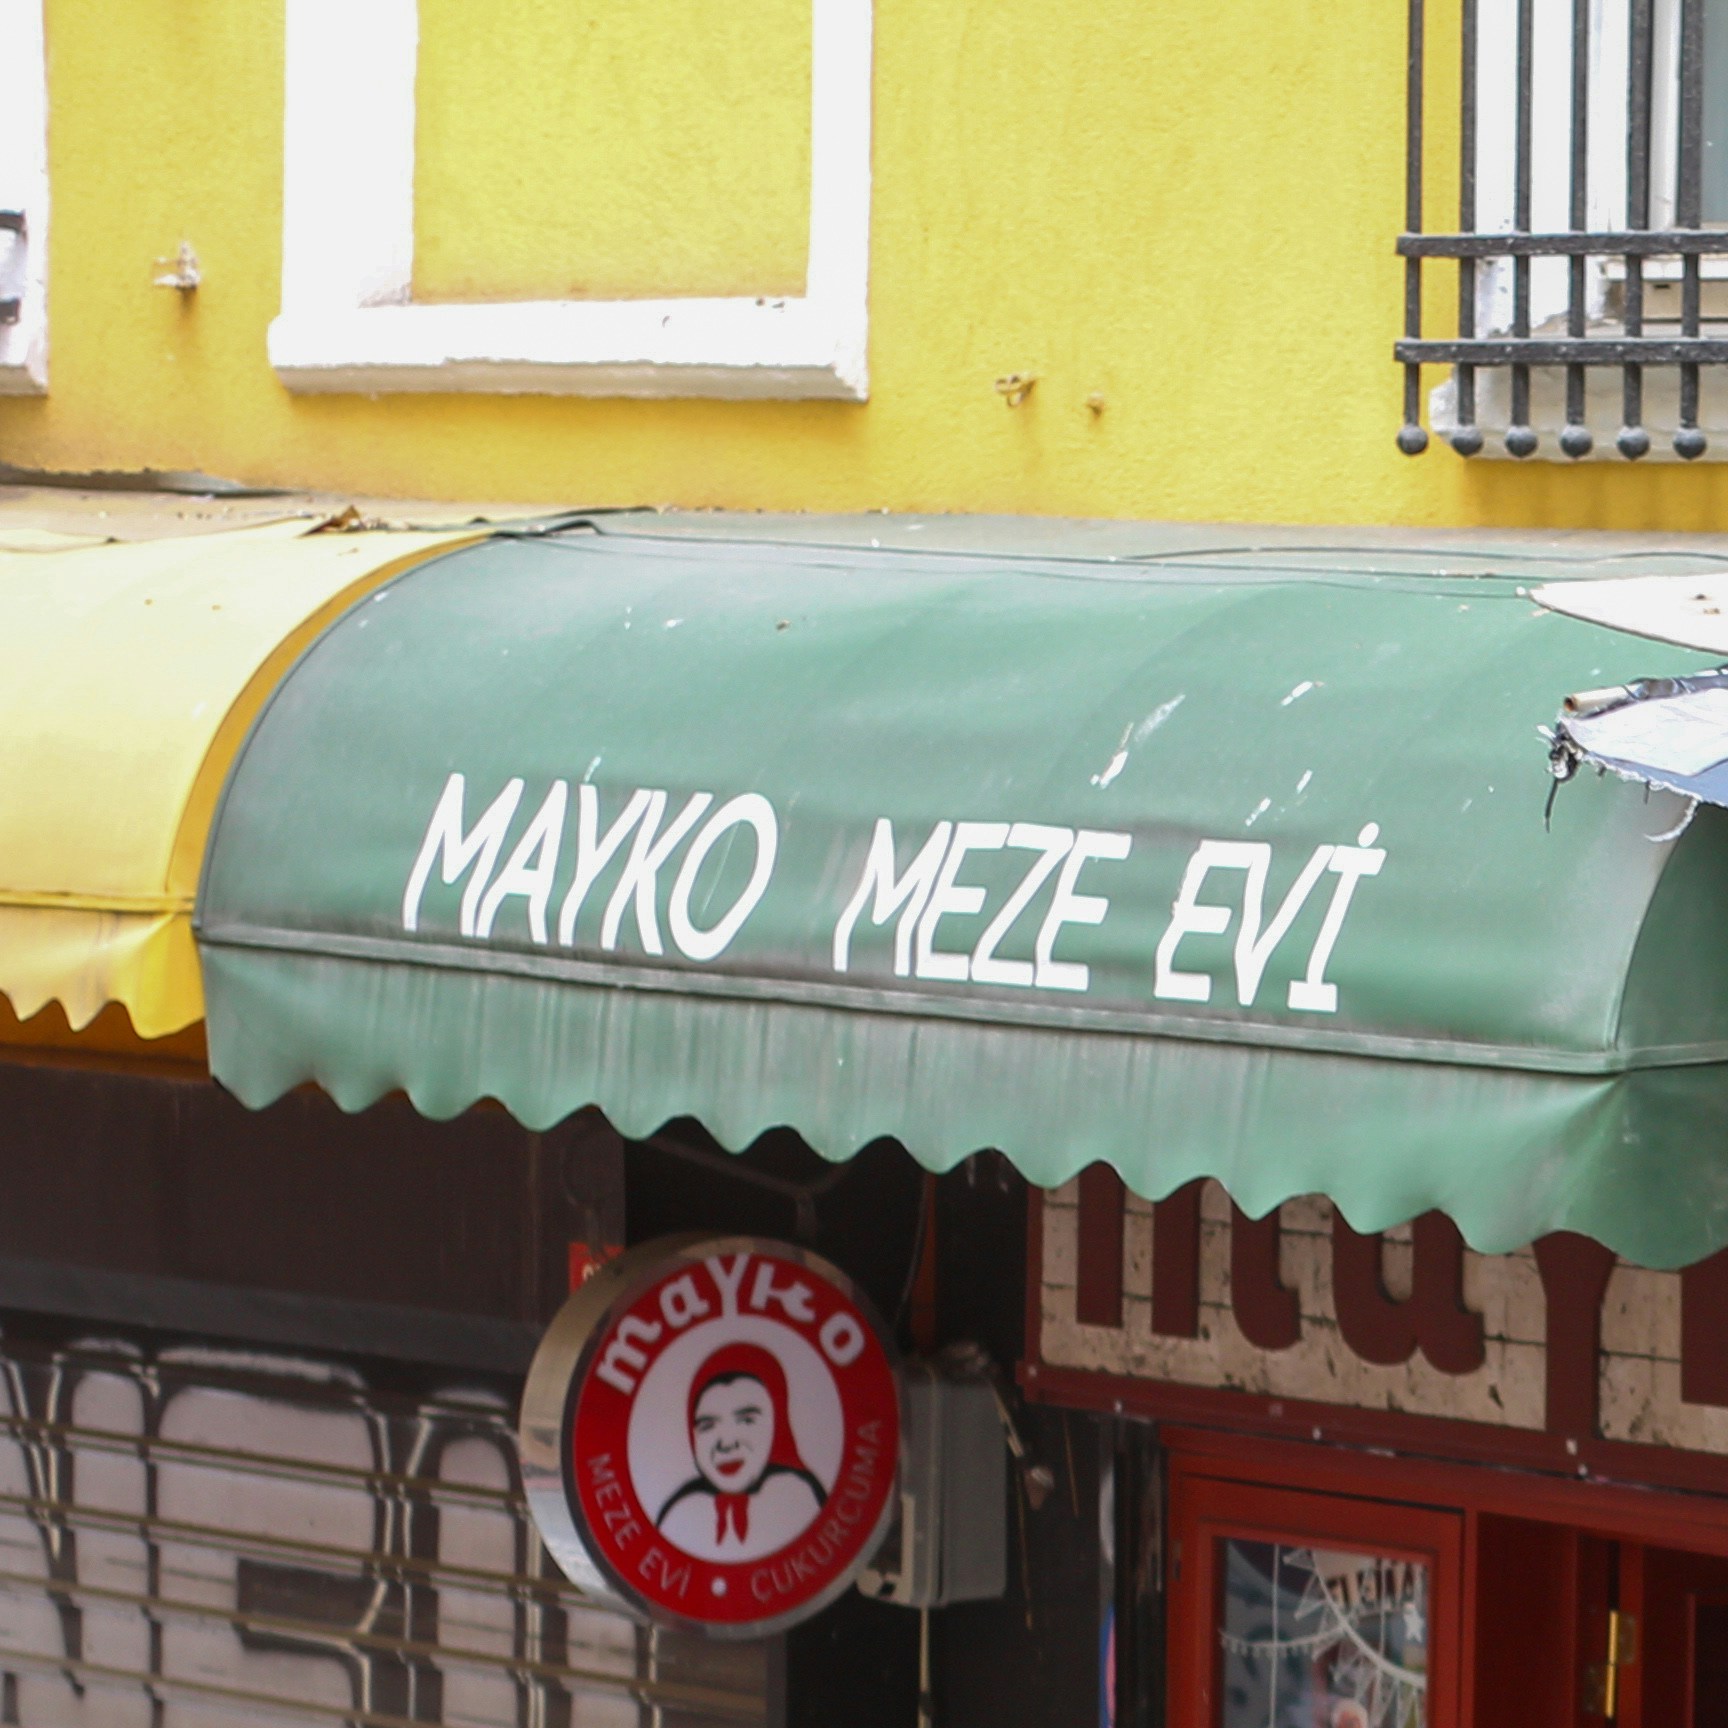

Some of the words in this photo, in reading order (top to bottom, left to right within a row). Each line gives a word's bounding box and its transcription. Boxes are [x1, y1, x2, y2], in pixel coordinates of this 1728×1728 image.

[402, 772, 778, 962] MAYKO
[832, 817, 1133, 992] MEZE
[1154, 822, 1387, 1013] EVİ
[587, 1453, 642, 1551] MEZE
